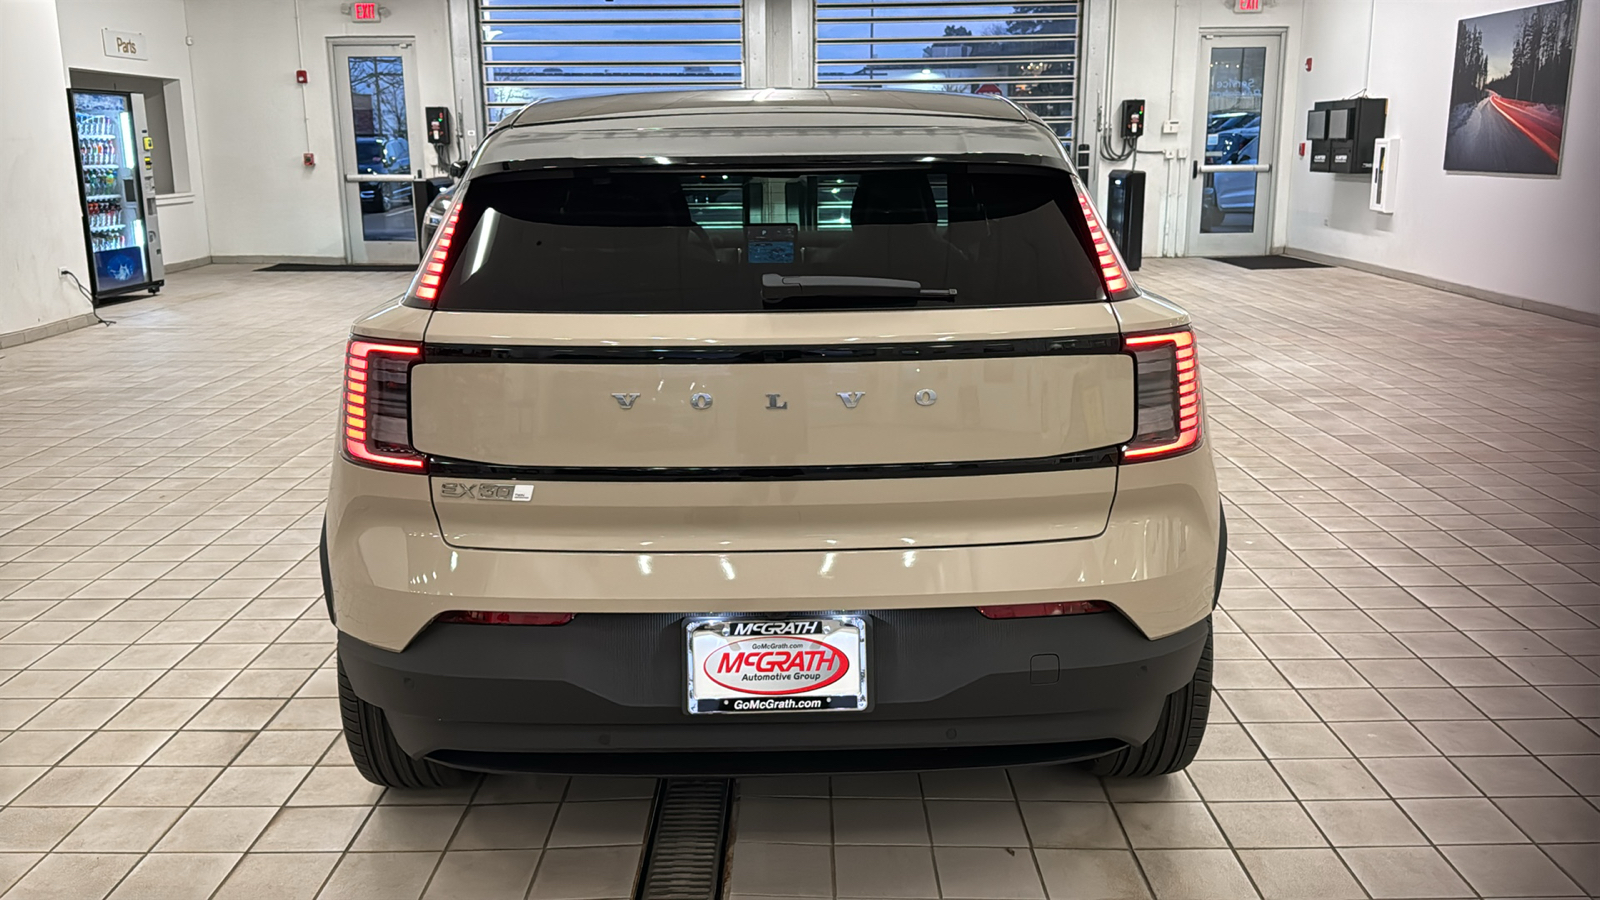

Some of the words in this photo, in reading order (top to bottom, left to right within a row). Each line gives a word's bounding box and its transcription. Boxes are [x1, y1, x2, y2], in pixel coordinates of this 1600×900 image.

[354, 2, 375, 19] EXIT
[116, 36, 137, 54] Parts
[611, 388, 938, 411] VOLVO
[741, 672, 792, 682] Automotive
[793, 672, 821, 682] Group
[734, 699, 822, 711] GoMcGrath.com
